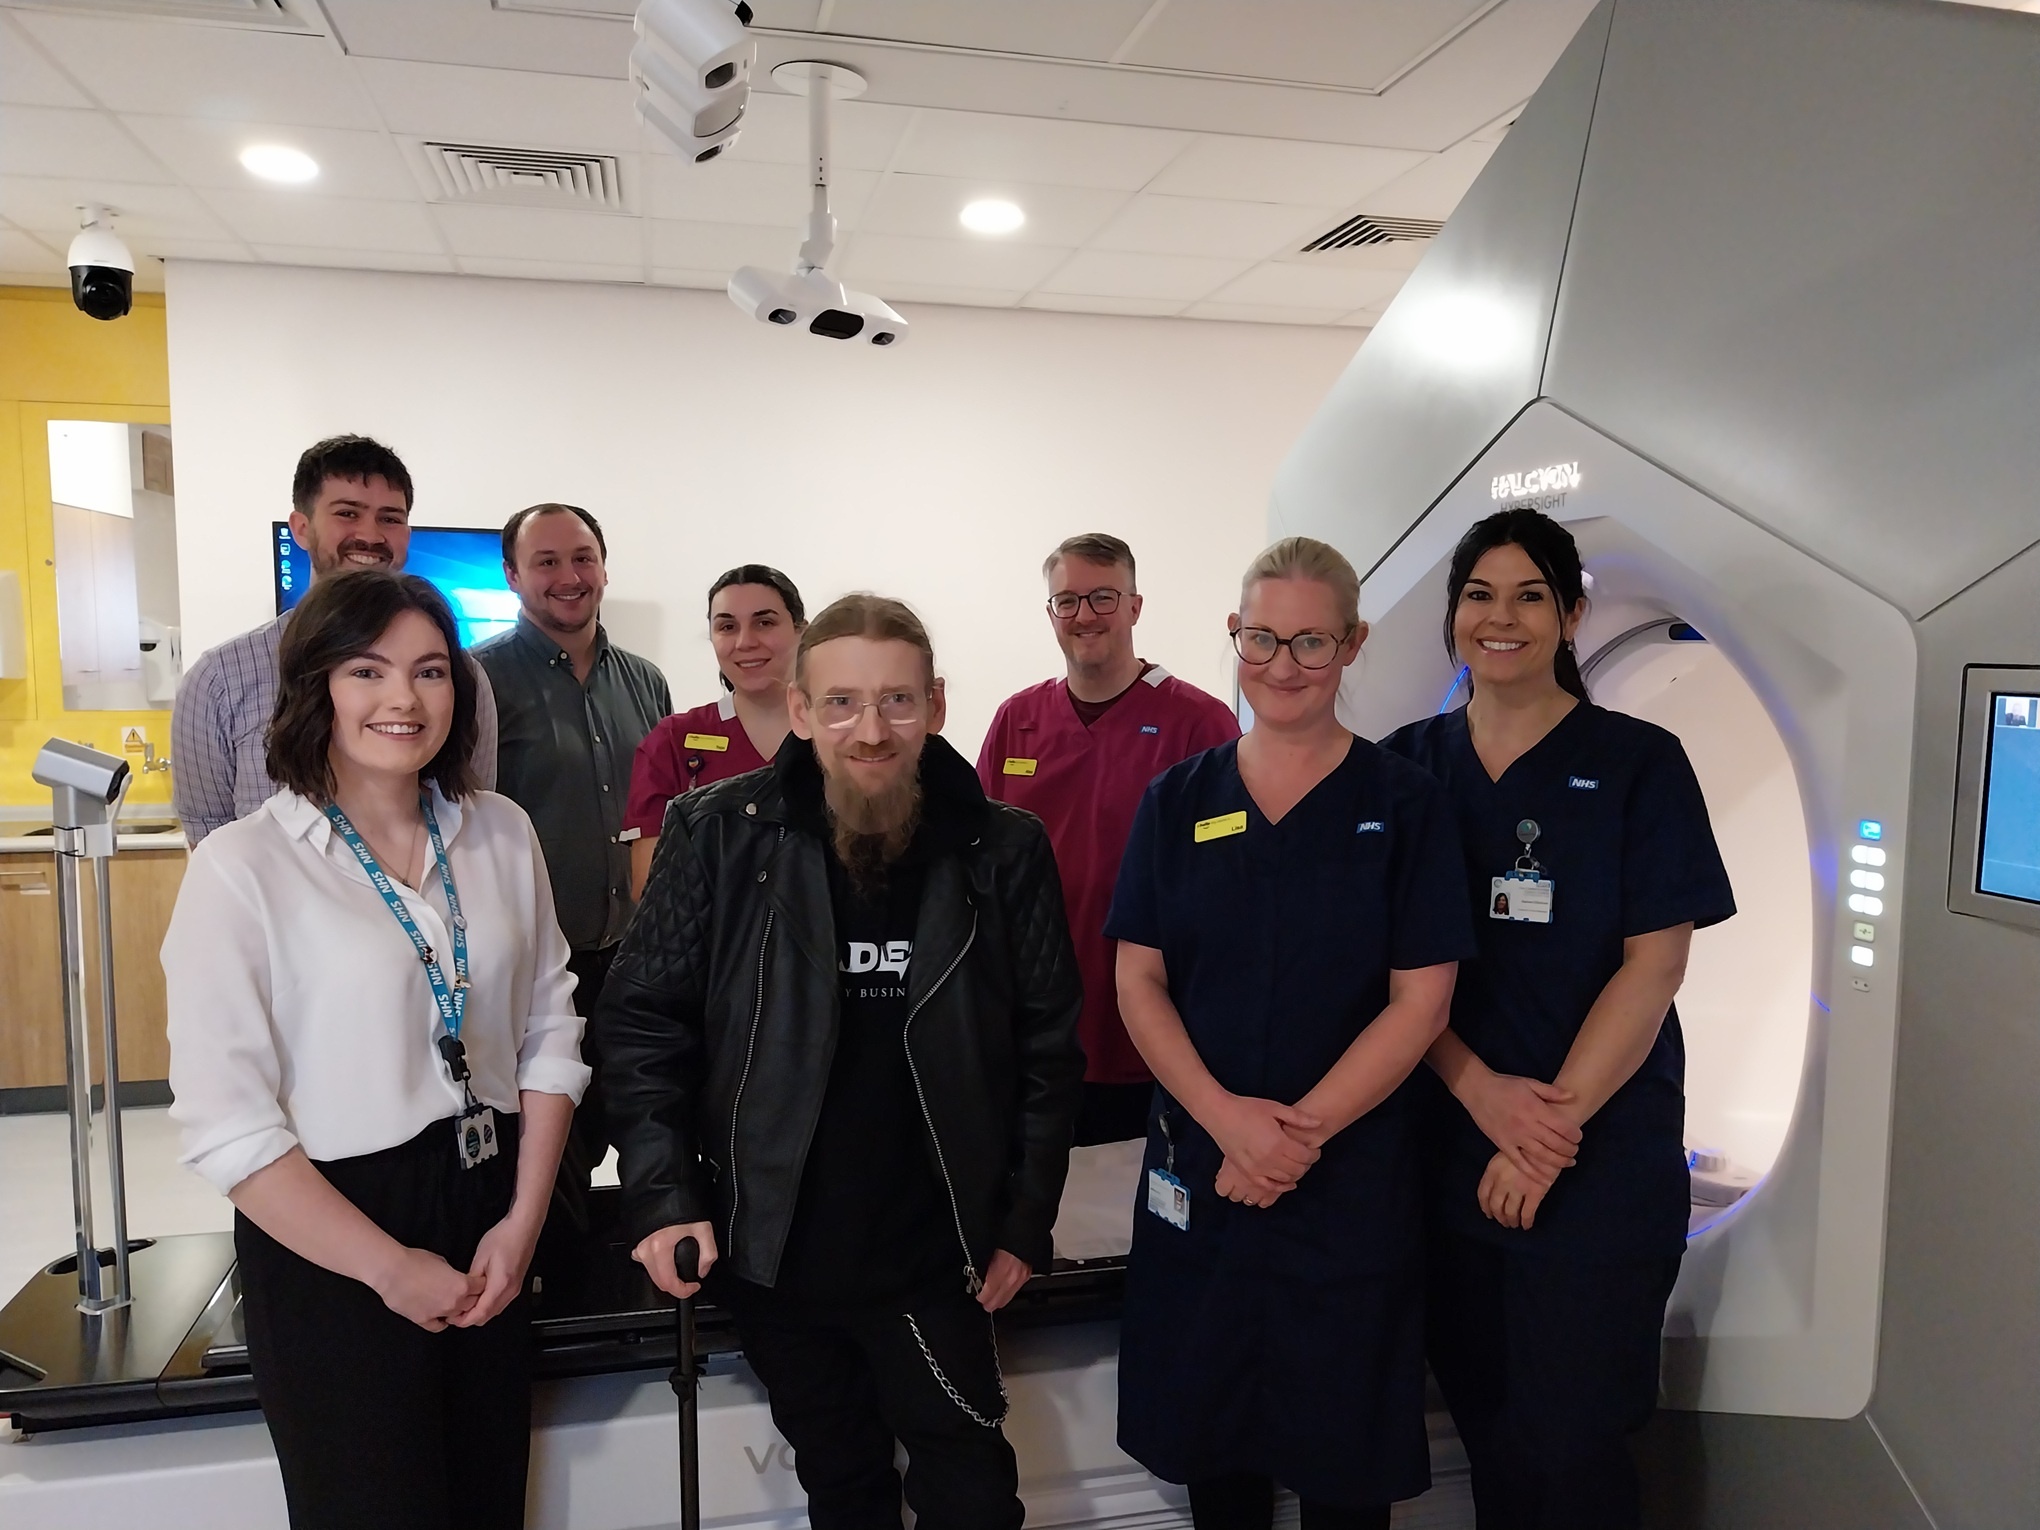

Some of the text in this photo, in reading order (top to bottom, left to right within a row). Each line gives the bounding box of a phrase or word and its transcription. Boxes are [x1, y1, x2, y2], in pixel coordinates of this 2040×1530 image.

[1491, 461, 1580, 499] HALCYON
[1500, 492, 1567, 513] HYPERSIGHT
[1571, 778, 1596, 789] NHS
[333, 814, 355, 836] NHS
[1359, 821, 1381, 831] NHS
[352, 842, 374, 865] NHS
[371, 871, 393, 894] NHS
[431, 833, 445, 856] NHS
[440, 862, 453, 886] NHS
[447, 892, 460, 917] NHS
[390, 900, 411, 923] NHS
[438, 993, 453, 1018] NHS
